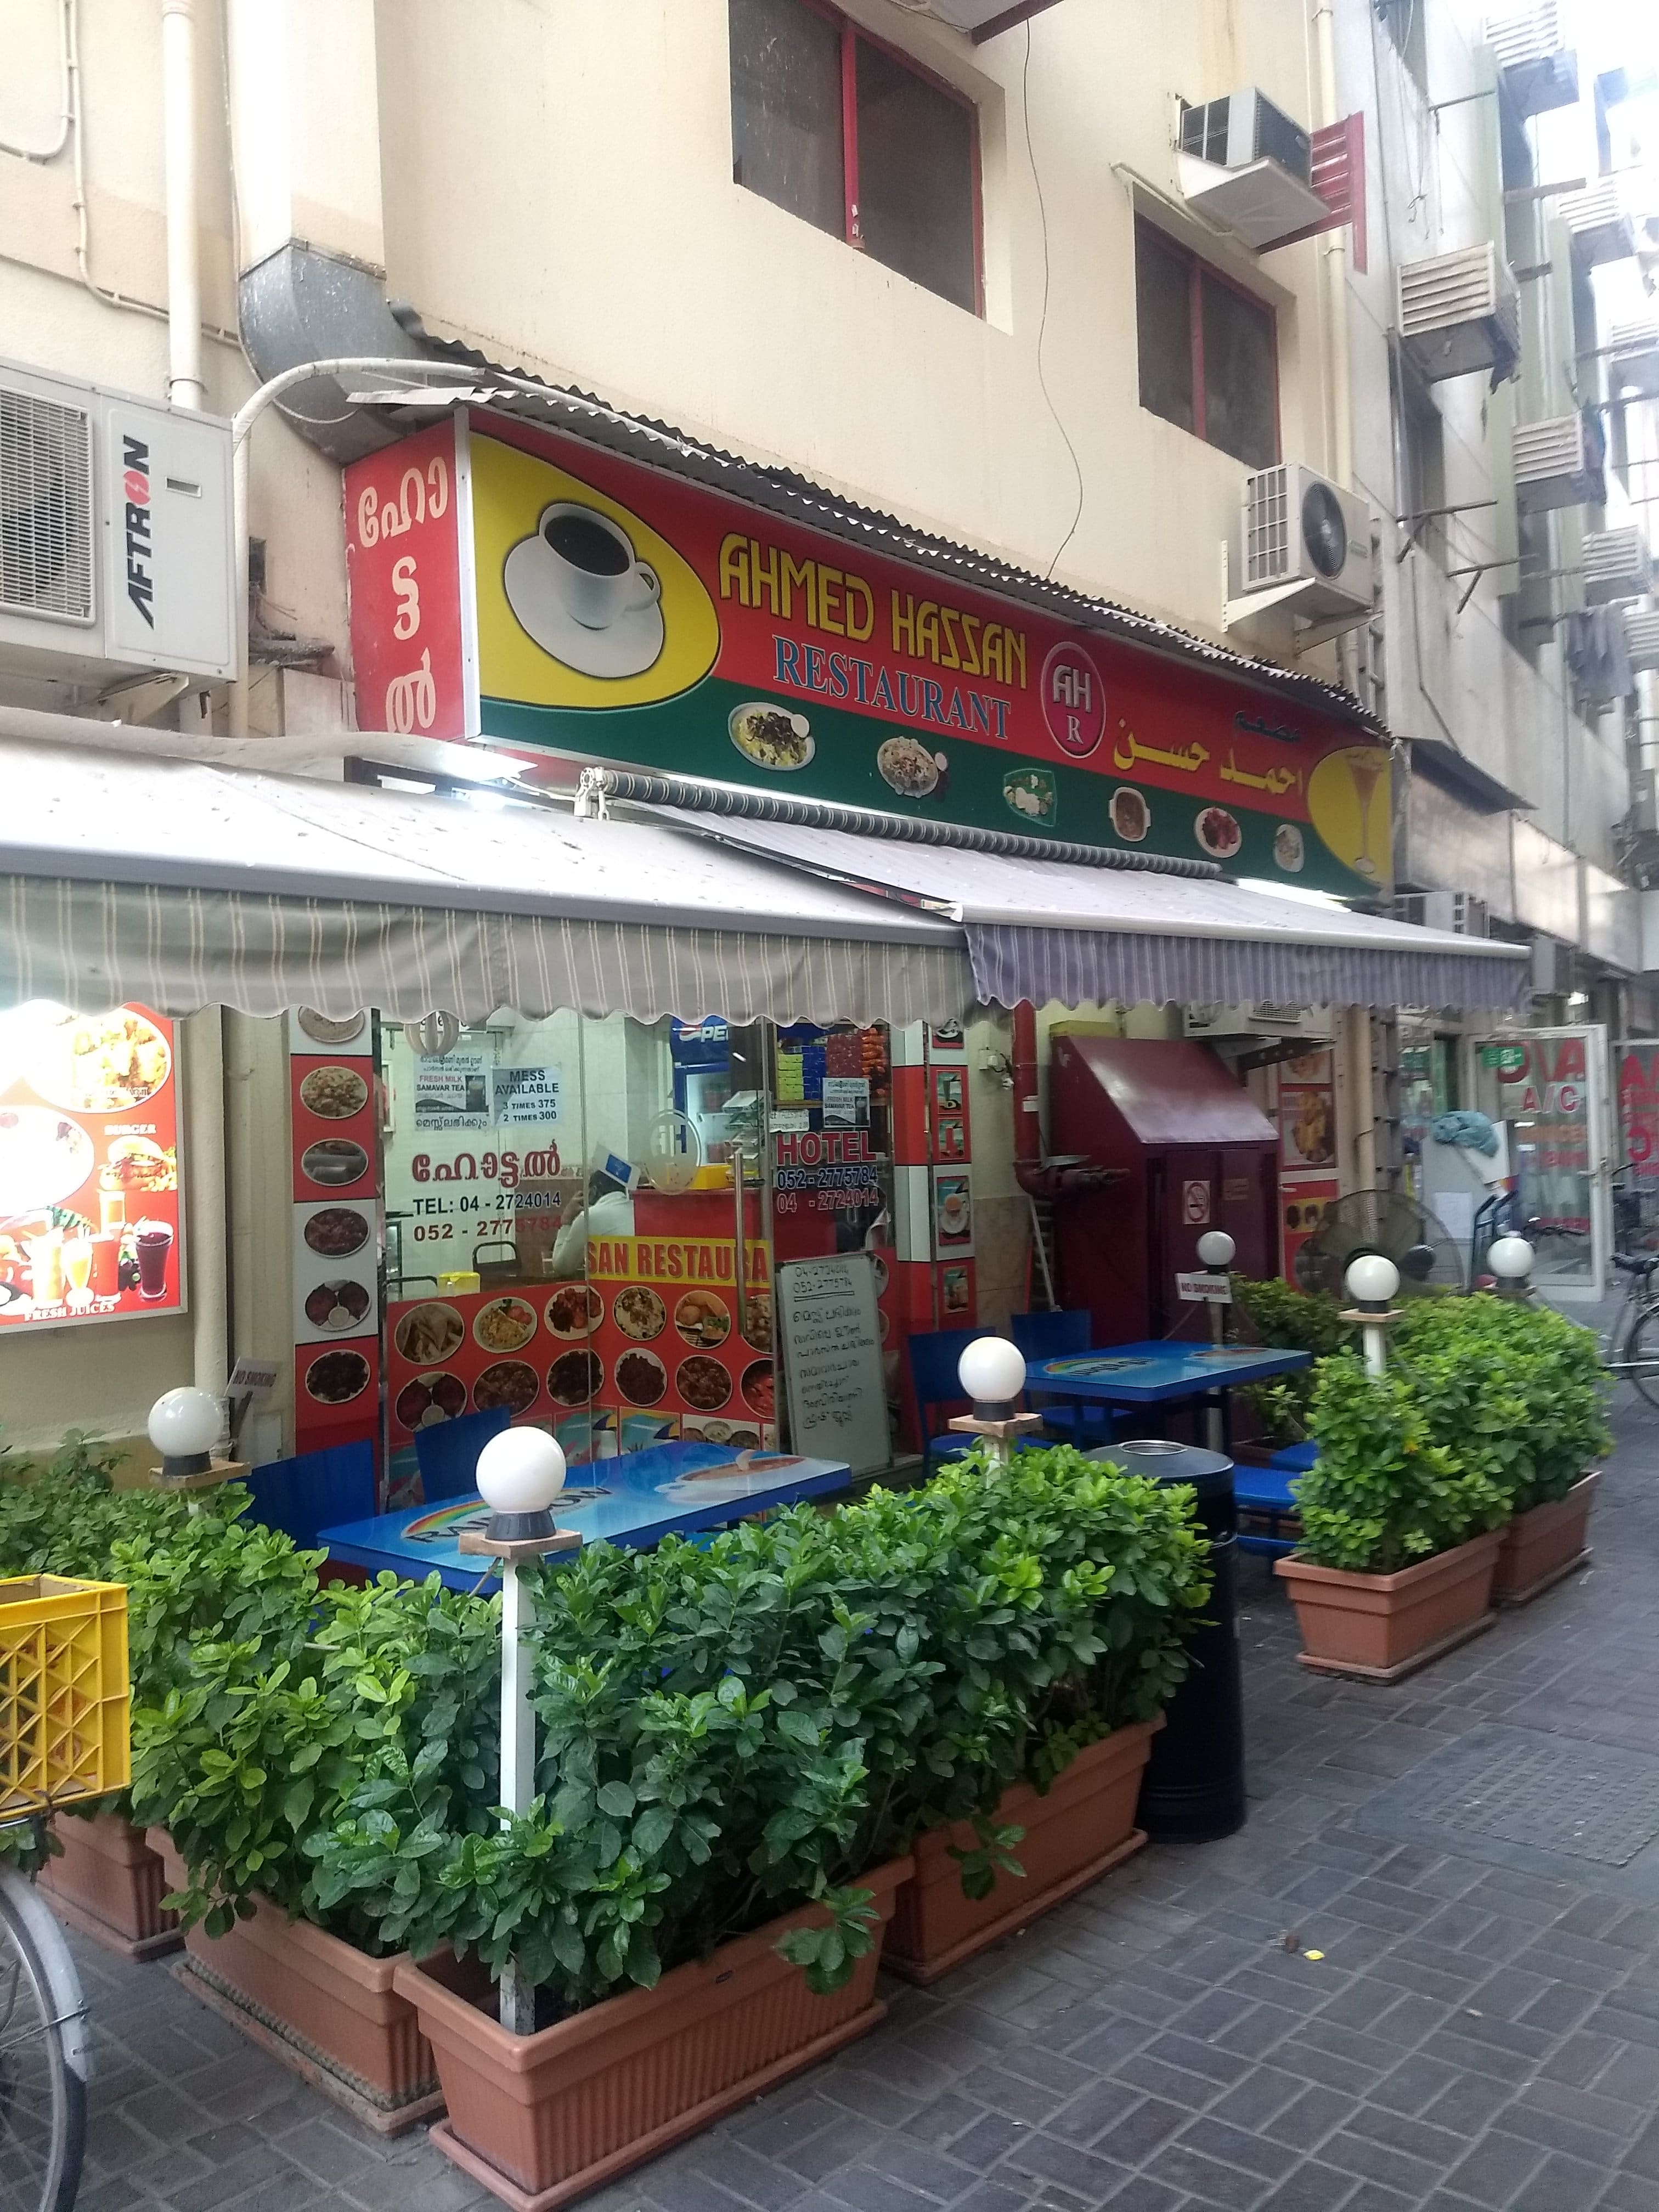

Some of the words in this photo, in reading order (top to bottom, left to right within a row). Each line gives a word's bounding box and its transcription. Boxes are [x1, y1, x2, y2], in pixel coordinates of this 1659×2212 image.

[122, 435, 155, 630] AFTRON
[719, 532, 874, 643] AHMED
[891, 589, 1028, 690] HASSAN
[772, 634, 1011, 740] RESTAURANT
[1052, 664, 1092, 713] AH
[1066, 715, 1082, 744] R
[1113, 718, 1210, 772] حسن
[495, 1083, 560, 1095] AVAILABLE
[510, 1070, 545, 1082] MESS
[503, 1102, 509, 1110] 3
[538, 1099, 556, 1108] 375
[539, 1111, 557, 1120] 300
[776, 1131, 878, 1166] HOTEL
[413, 1197, 454, 1215] TEL:
[460, 1195, 479, 1212] 04
[495, 1192, 561, 1210] 2724014
[414, 1223, 454, 1242] 052
[24, 1306, 67, 1322] FRESH
[70, 1302, 115, 1317] JUICES
